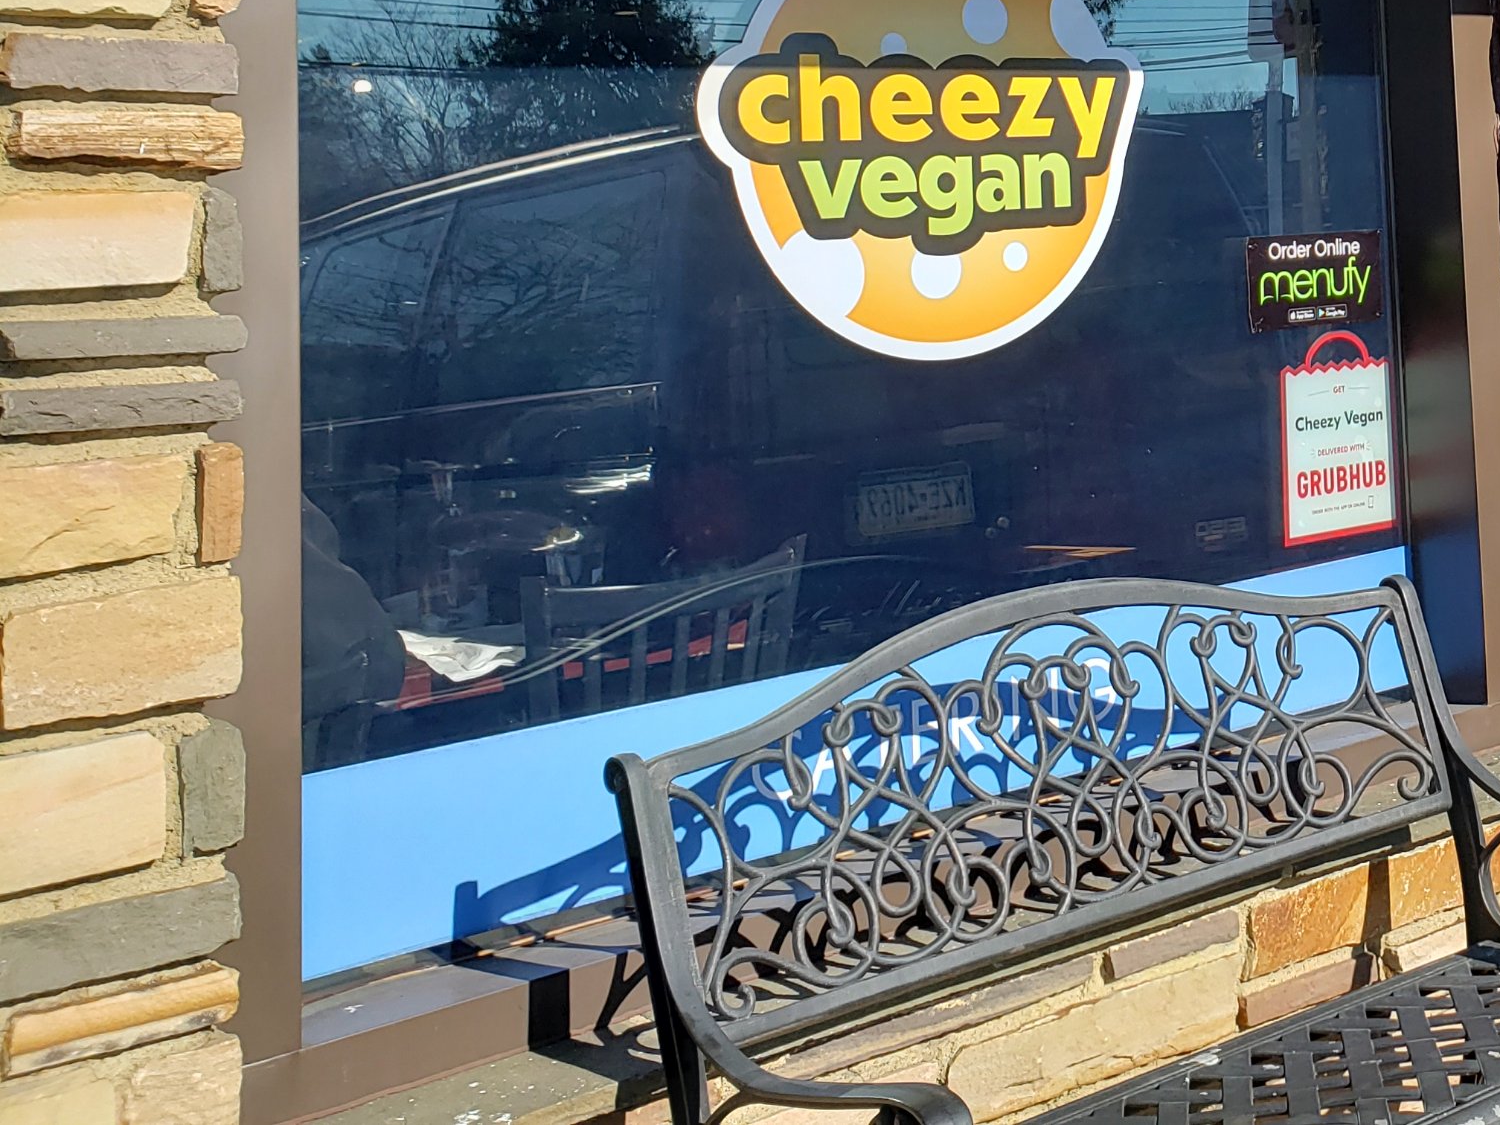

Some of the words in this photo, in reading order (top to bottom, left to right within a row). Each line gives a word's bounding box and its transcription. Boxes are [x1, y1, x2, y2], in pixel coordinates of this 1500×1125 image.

[738, 54, 1116, 158] cheezy
[799, 152, 1072, 235] vegan
[1268, 240, 1312, 260] Order
[1314, 237, 1361, 257] Online
[1260, 256, 1371, 306] menufy
[1332, 385, 1345, 394] GET
[1295, 416, 1341, 432] Cheezy
[1344, 410, 1383, 427] Vegan
[1317, 446, 1348, 457] DELIVERED
[1350, 443, 1365, 452] WITH
[1297, 459, 1387, 499] GRUBHUB
